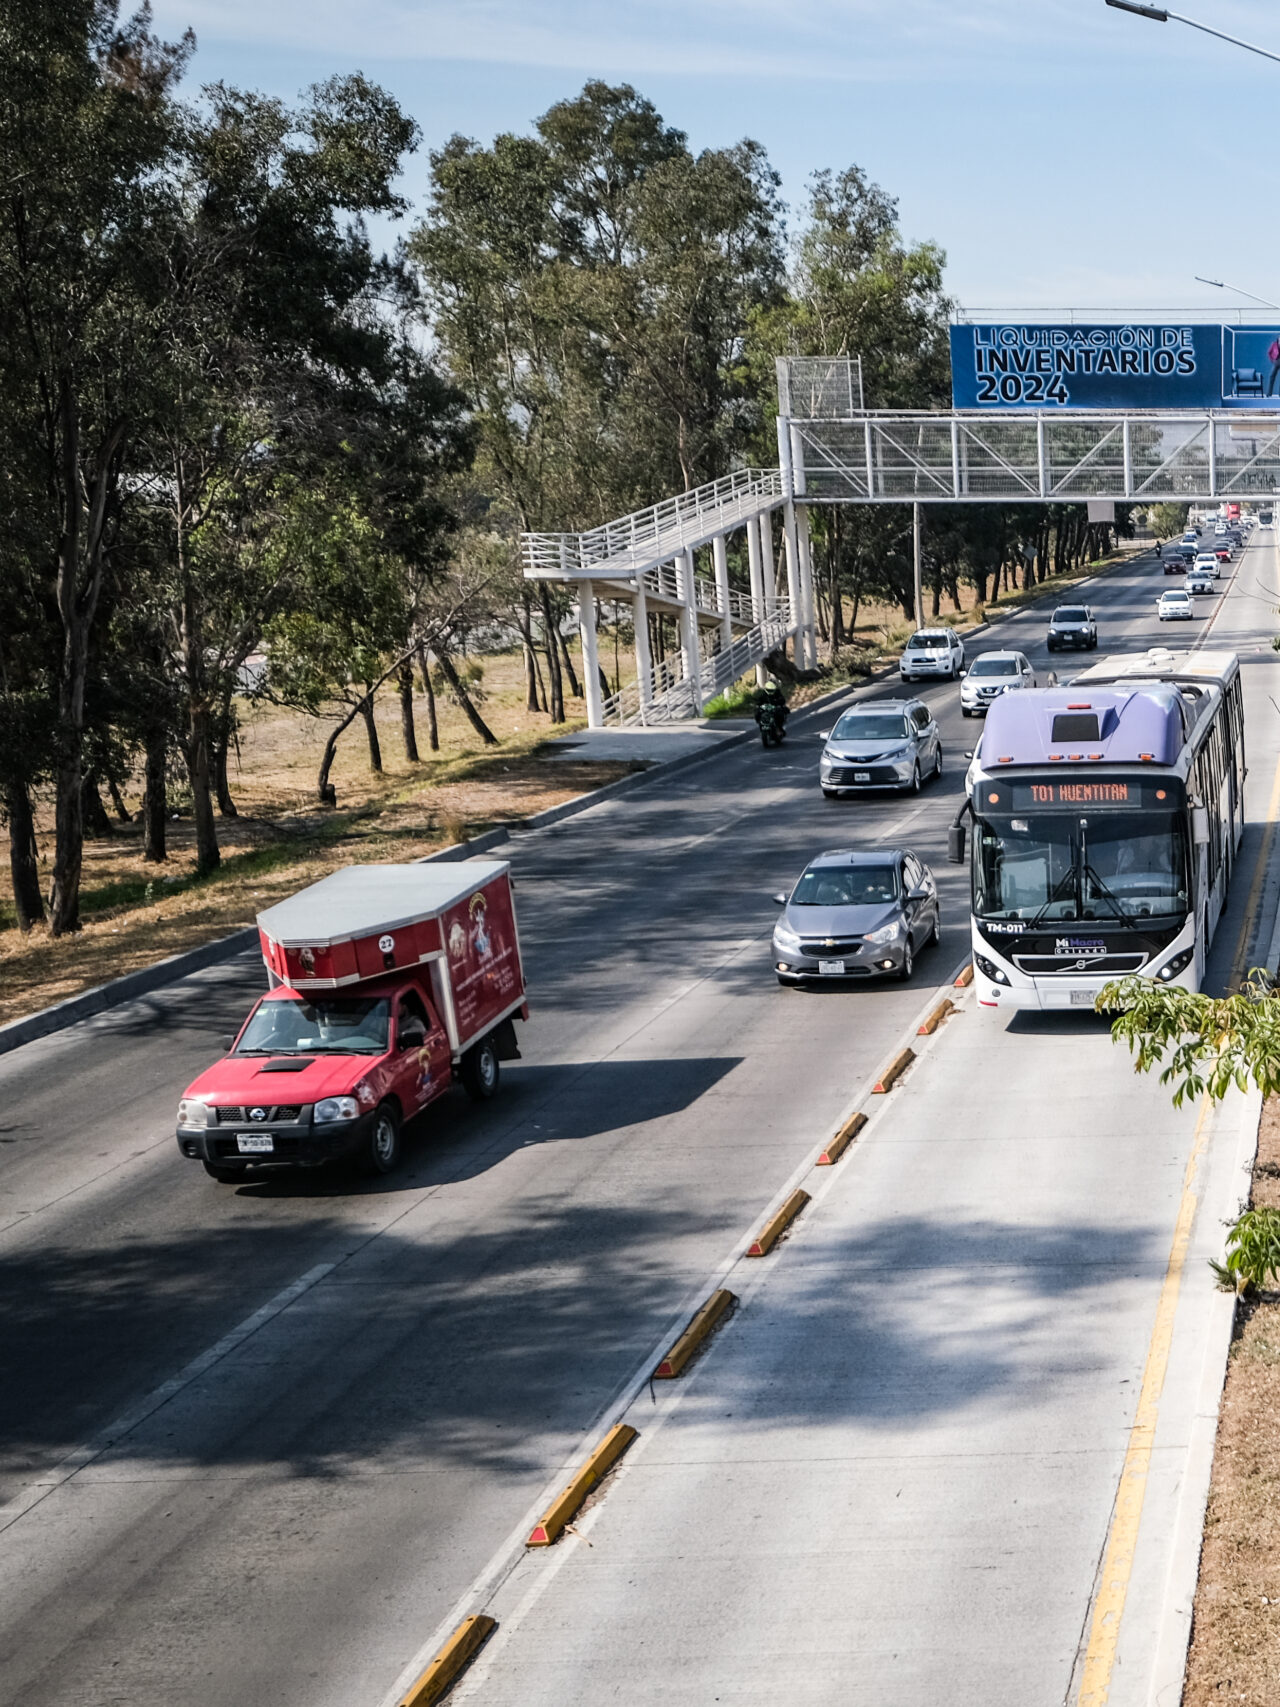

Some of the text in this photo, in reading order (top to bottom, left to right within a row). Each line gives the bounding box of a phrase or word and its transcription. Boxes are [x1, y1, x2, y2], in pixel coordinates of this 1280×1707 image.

[974, 325, 1193, 348] LIQUIDACIÓN DE
[975, 348, 1196, 374] INVENTARIOS
[976, 375, 1069, 404] 2024
[1059, 783, 1128, 802] HUENTITAN
[1055, 938, 1105, 947] Mi Macro
